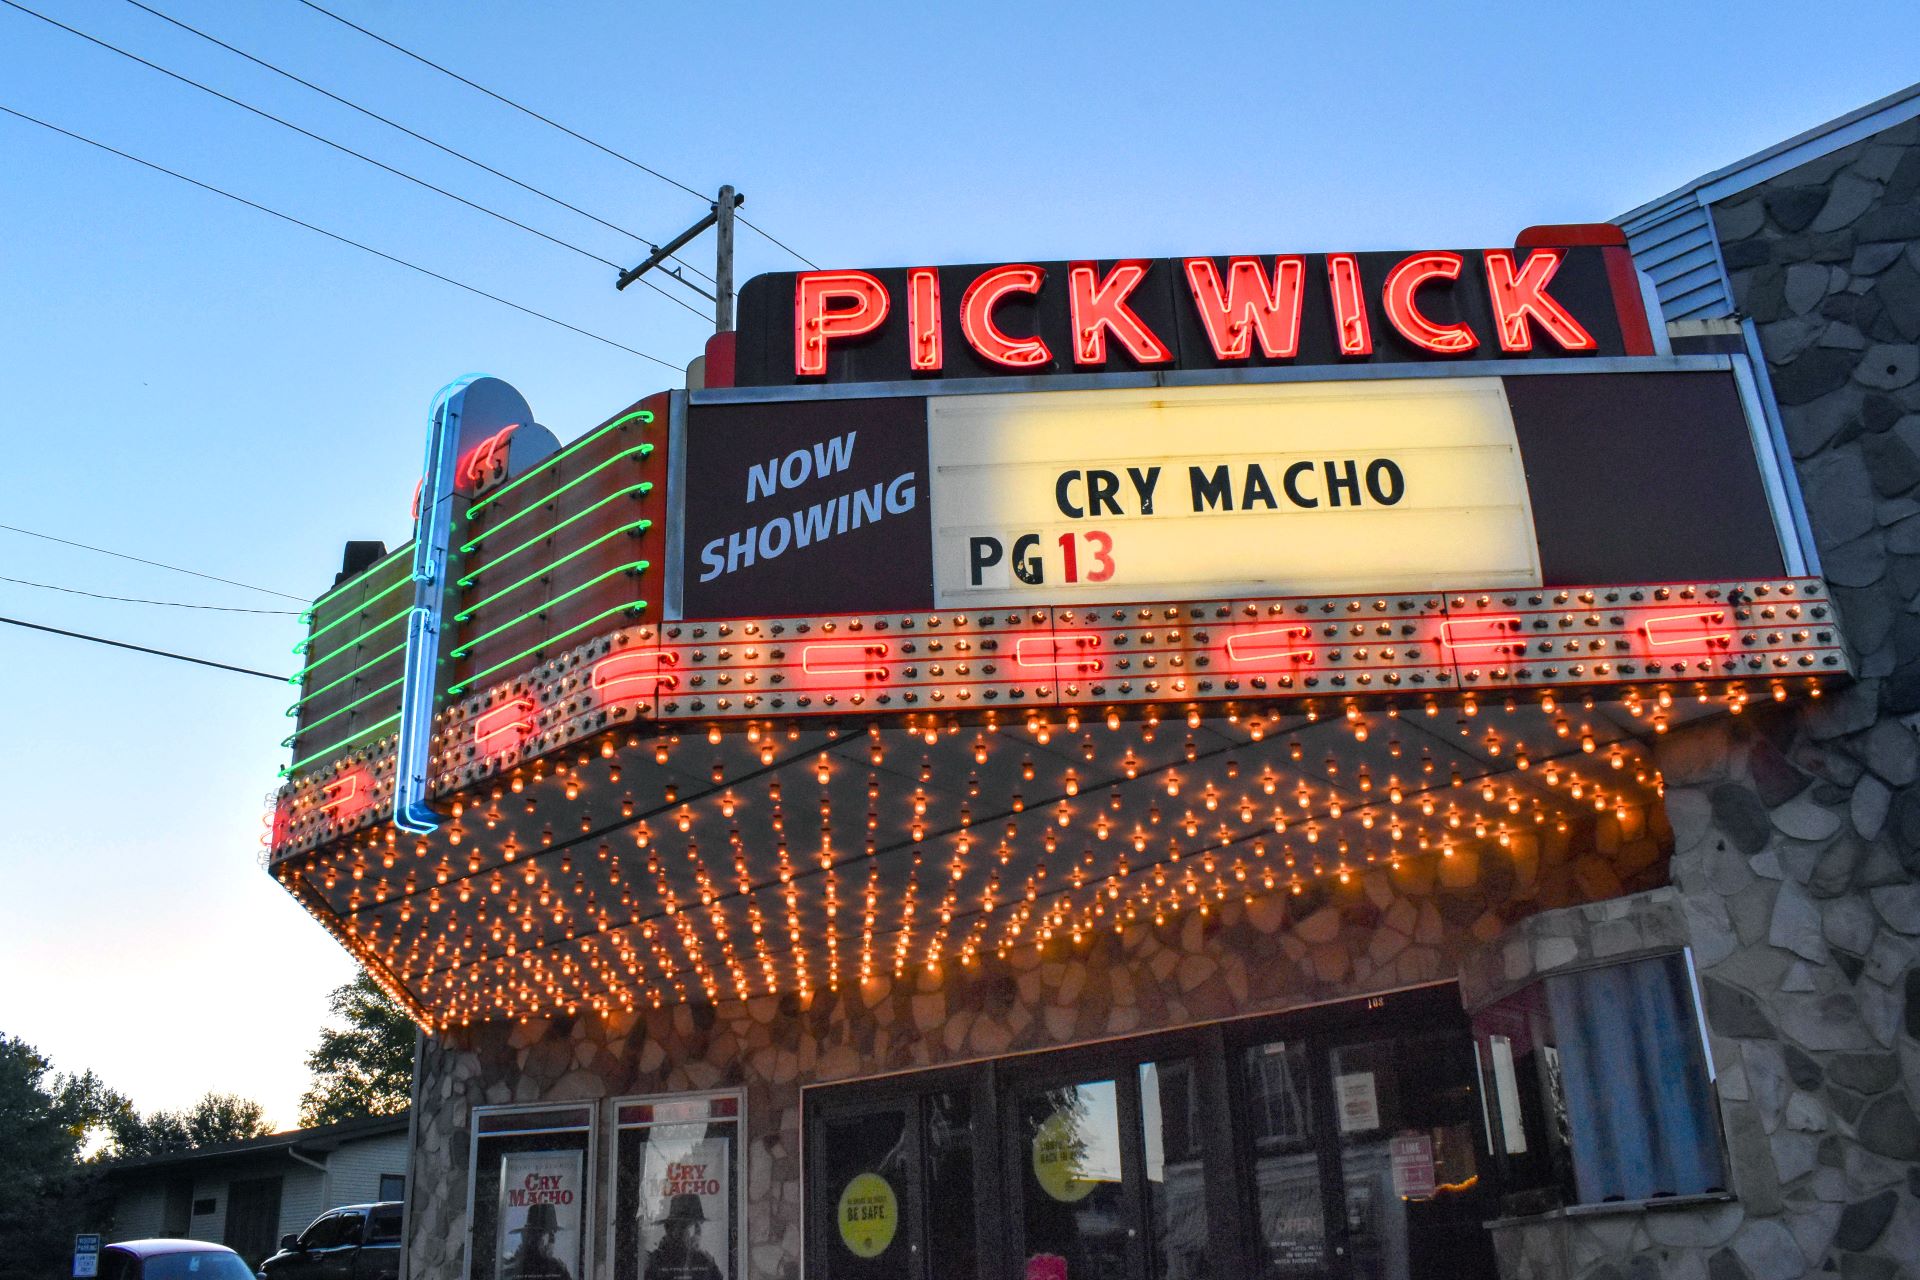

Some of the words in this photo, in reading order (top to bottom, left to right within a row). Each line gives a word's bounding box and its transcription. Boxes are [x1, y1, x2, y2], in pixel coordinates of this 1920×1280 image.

[795, 248, 1599, 376] PICKWICK
[746, 431, 857, 503] NOW
[1055, 466, 1161, 518] CRY
[1189, 458, 1404, 513] MACHO
[700, 472, 917, 582] SHOWING
[525, 1173, 563, 1191] CRY
[667, 1162, 707, 1181] CRY
[508, 1189, 574, 1207] MACHO
[847, 1207, 858, 1222] BE
